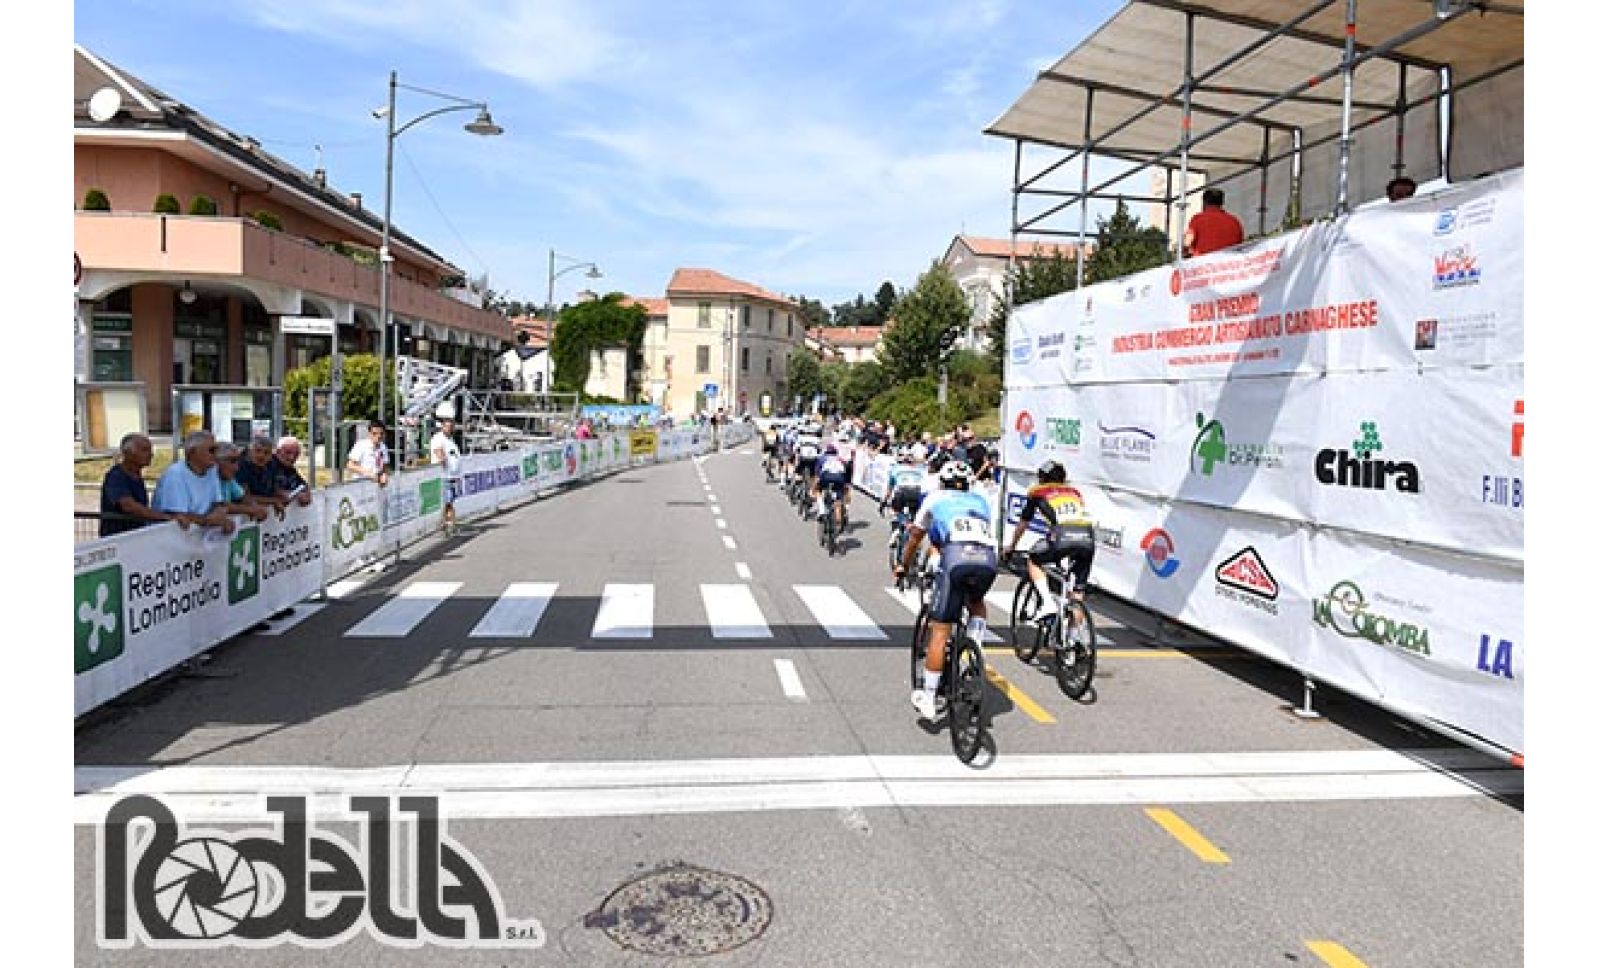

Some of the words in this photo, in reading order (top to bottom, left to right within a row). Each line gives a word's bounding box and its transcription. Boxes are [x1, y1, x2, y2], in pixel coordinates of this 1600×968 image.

[1285, 300, 1378, 335] CARNAGHESE
[1314, 448, 1421, 494] Chira
[262, 525, 309, 554] Regione
[129, 559, 204, 601] Regione
[262, 543, 321, 580] Lombardia
[129, 581, 222, 634] Lombardia
[1477, 634, 1514, 679] LA
